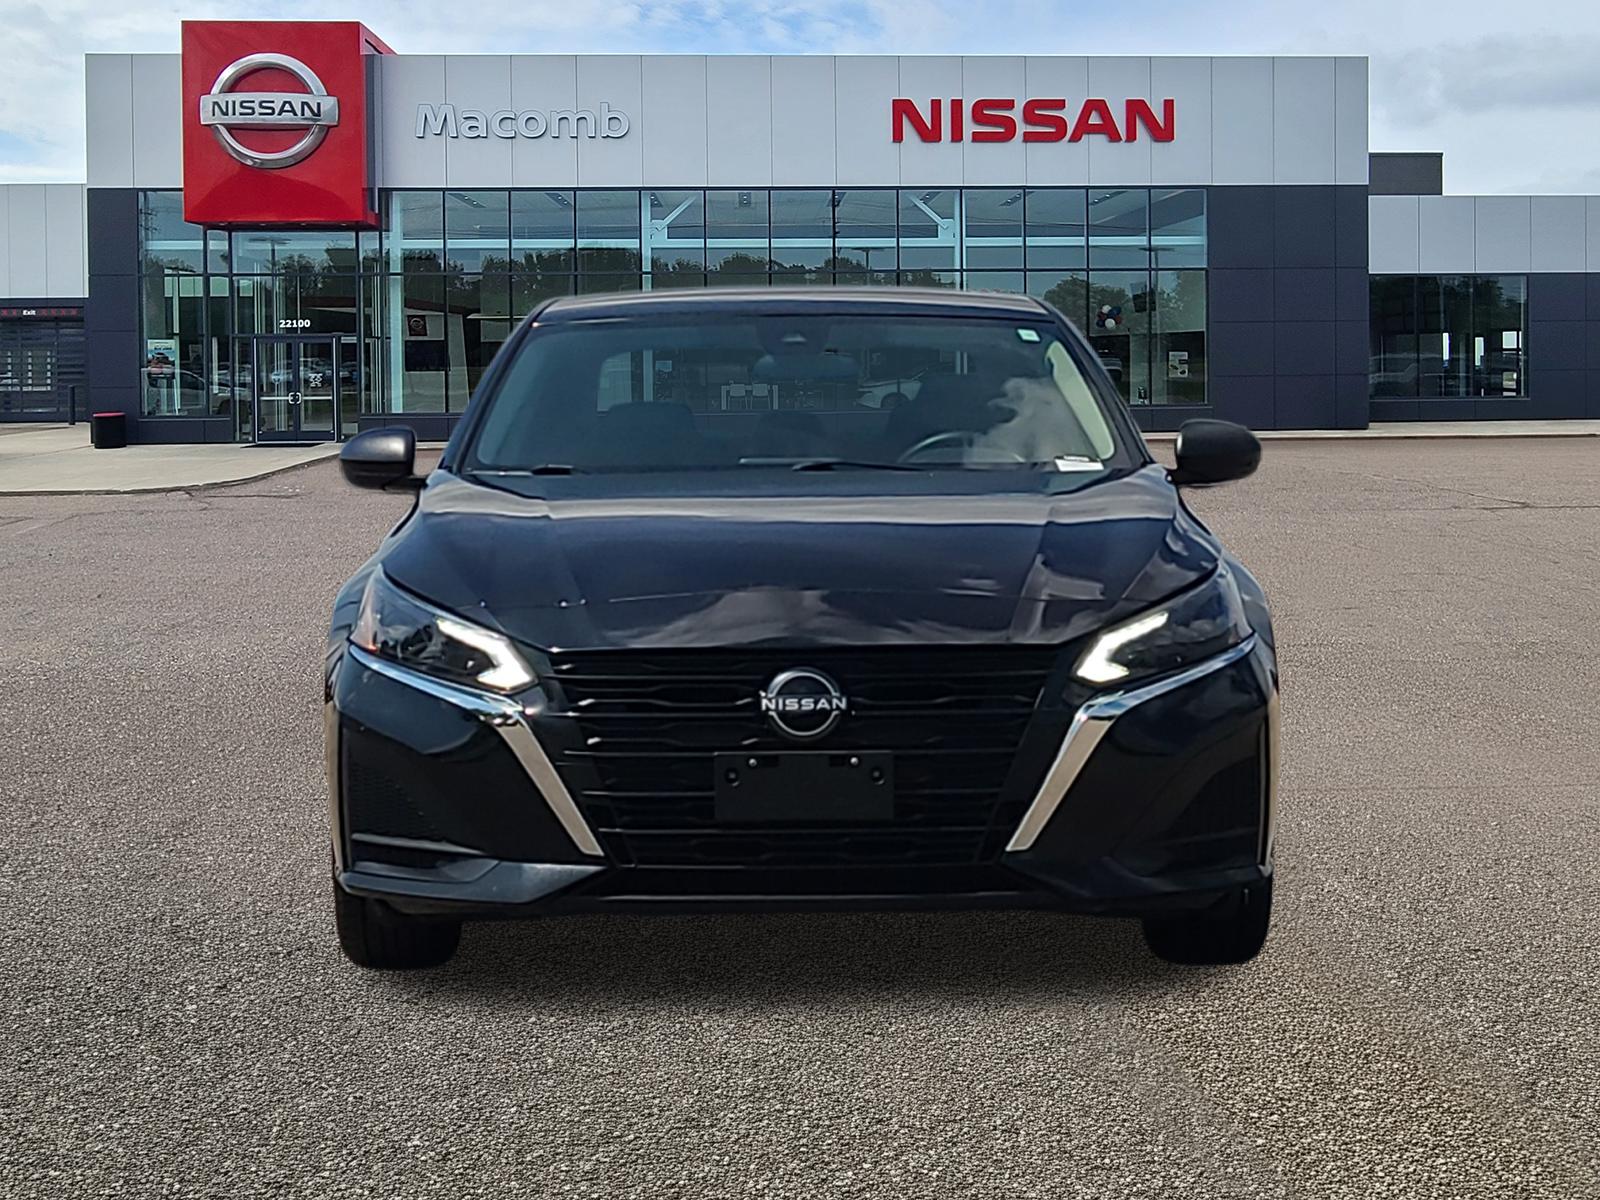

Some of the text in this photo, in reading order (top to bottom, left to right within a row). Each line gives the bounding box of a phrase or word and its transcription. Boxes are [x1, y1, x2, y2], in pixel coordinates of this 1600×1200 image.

[211, 100, 323, 118] NISSAN
[414, 102, 631, 139] Macomb
[892, 98, 1176, 143] NISSAN
[279, 319, 311, 328] 22100
[761, 697, 847, 711] NISSAN
